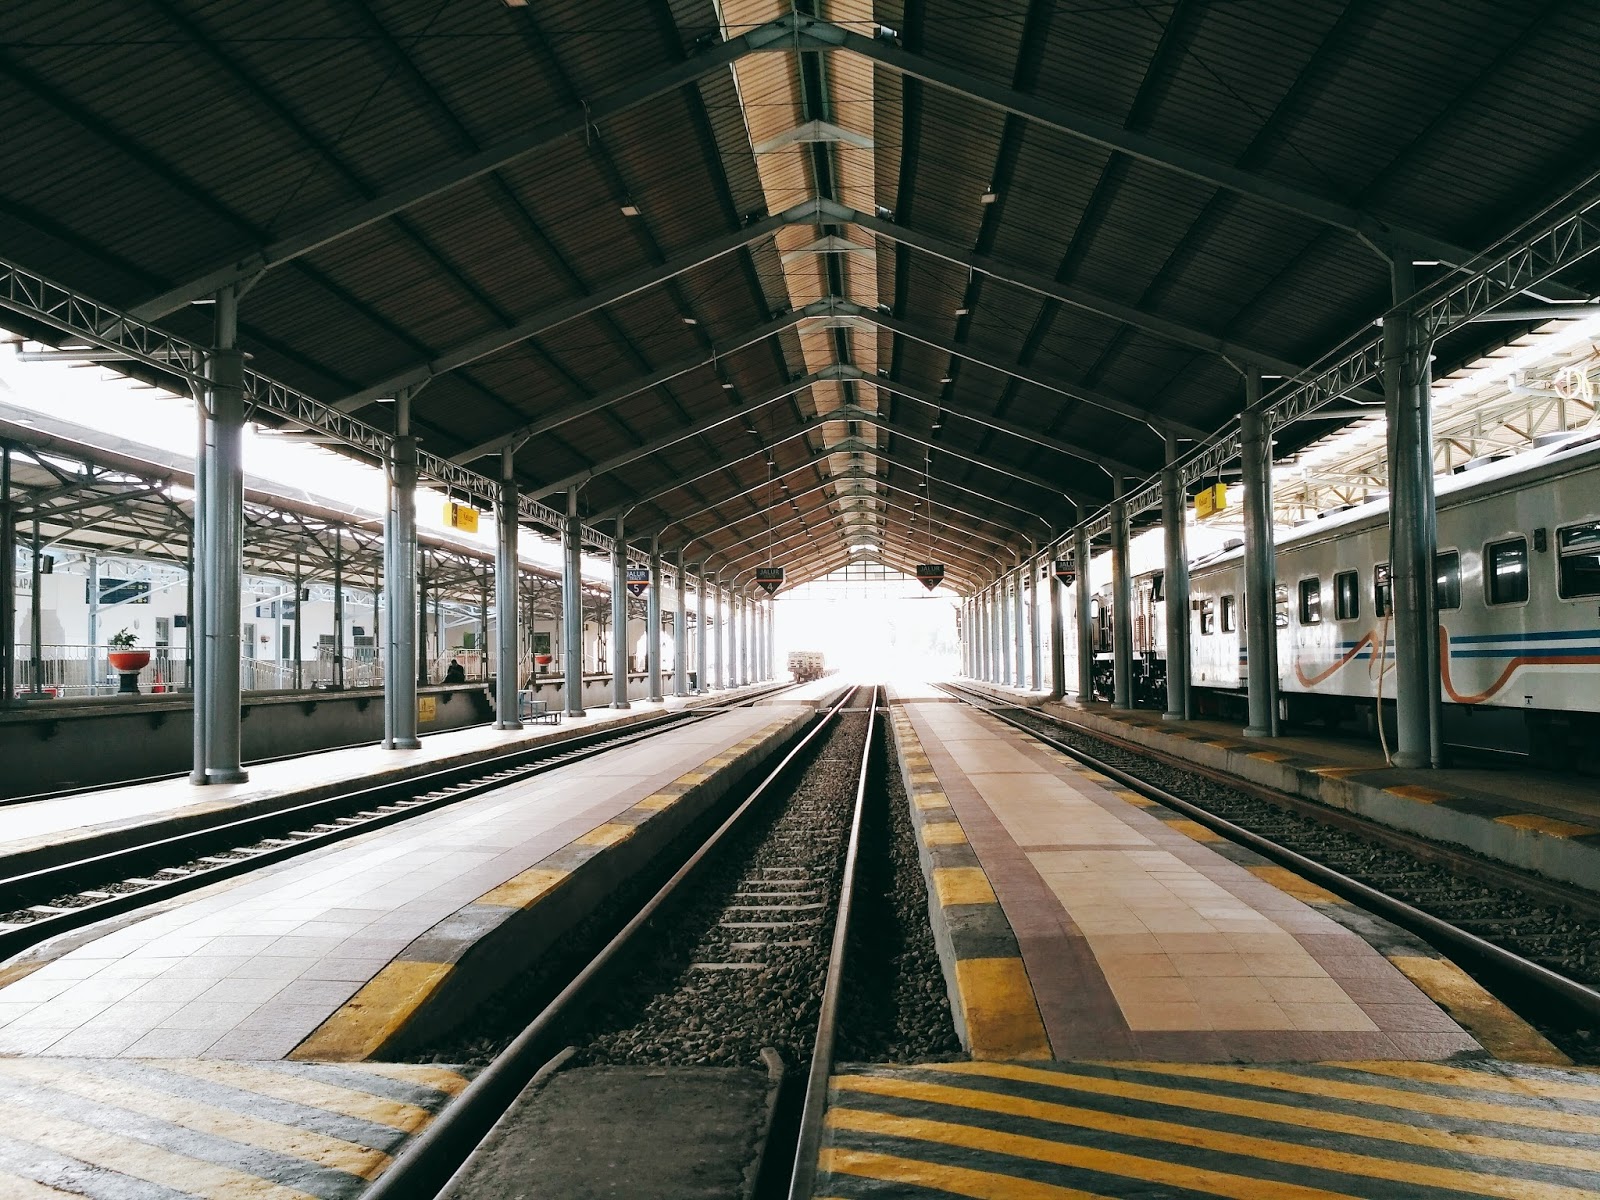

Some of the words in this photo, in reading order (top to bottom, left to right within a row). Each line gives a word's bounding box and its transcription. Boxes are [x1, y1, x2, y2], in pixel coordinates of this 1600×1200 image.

[928, 579, 934, 587] 3
[1066, 575, 1073, 583] 2
[633, 584, 640, 593] 5
[767, 582, 773, 590] 4
